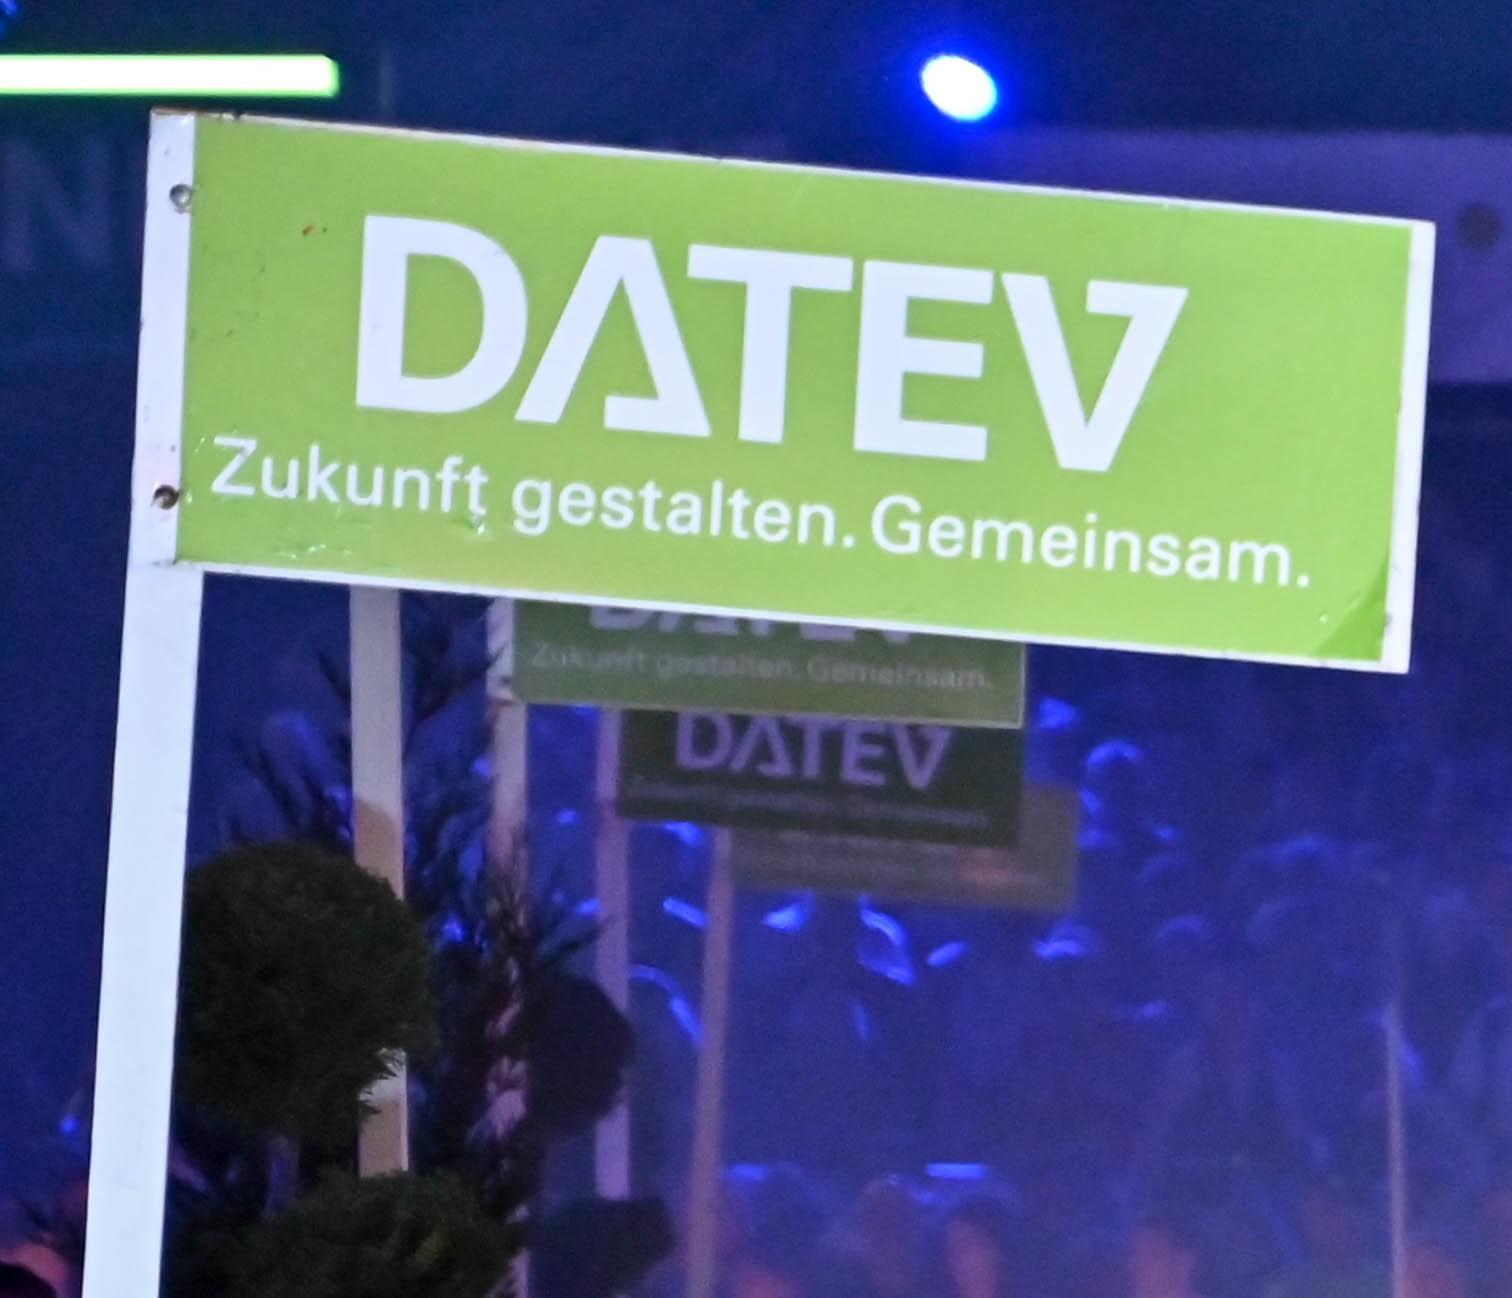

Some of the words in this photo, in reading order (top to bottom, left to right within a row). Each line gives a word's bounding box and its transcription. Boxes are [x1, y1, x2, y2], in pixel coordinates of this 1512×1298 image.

[355, 214, 1188, 473] DATEV
[209, 434, 488, 516] Zukunft
[509, 470, 859, 550] gestalten.
[870, 492, 1312, 588] Gemeinsam.
[673, 710, 953, 790] DATEV
